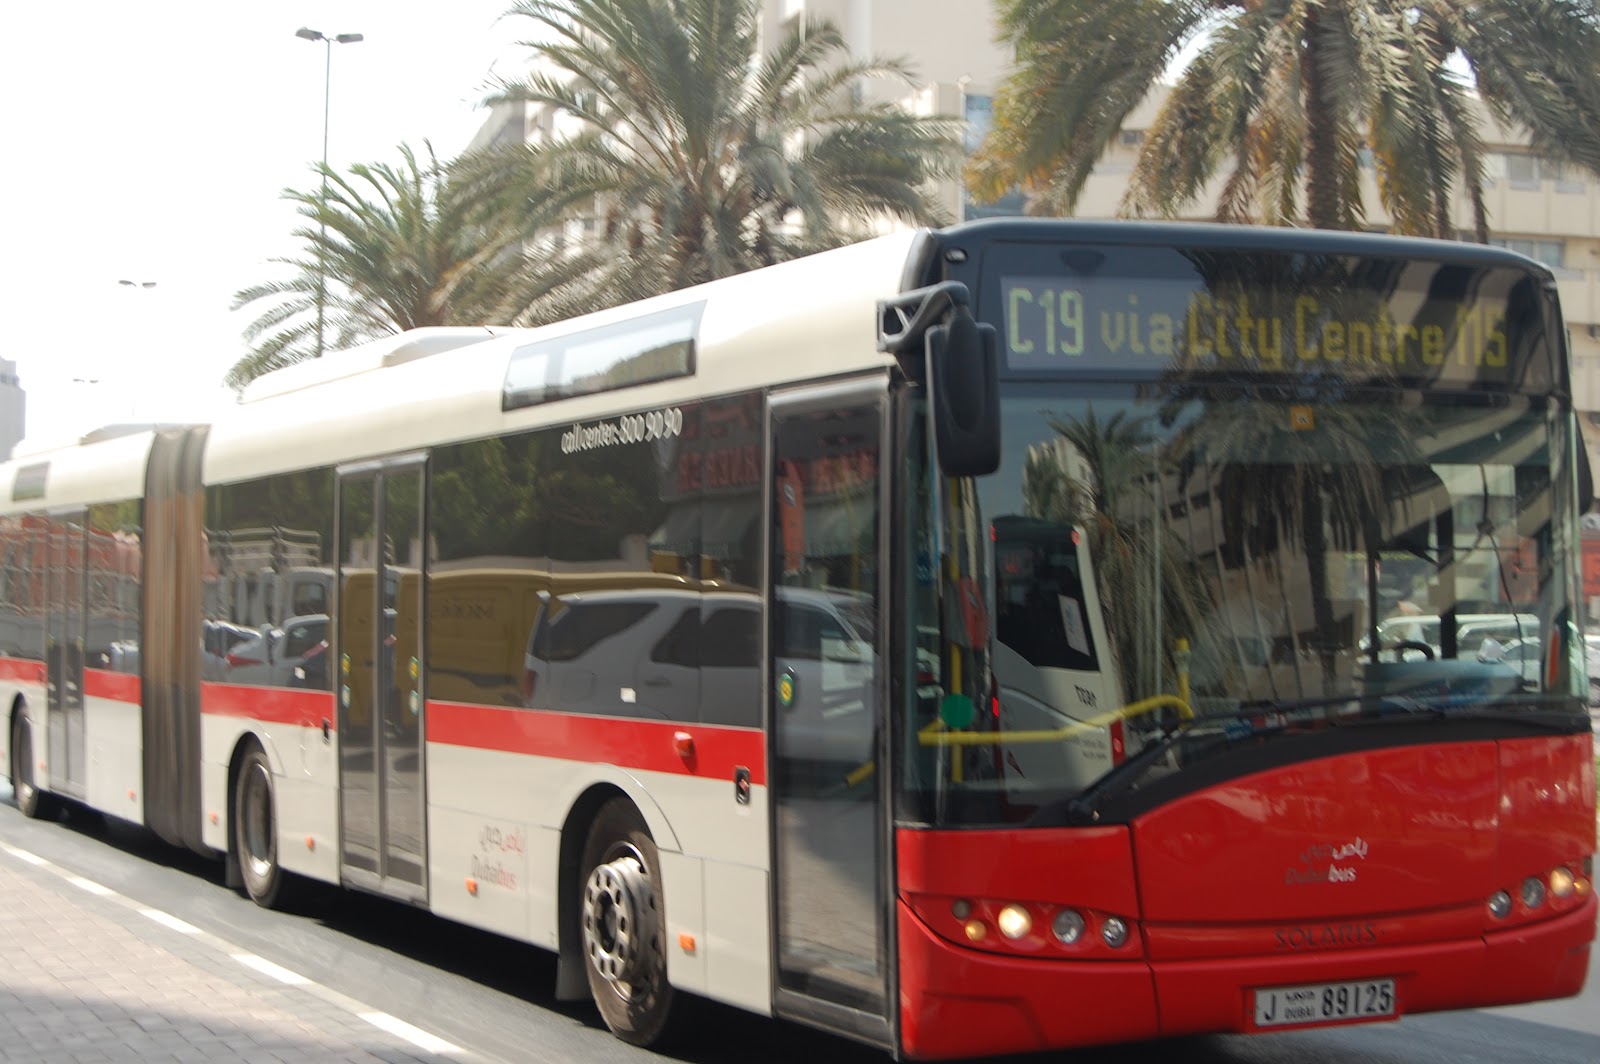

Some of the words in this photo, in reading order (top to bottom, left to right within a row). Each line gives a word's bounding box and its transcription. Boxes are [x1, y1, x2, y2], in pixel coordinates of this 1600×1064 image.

[1008, 287, 1084, 357] C19
[1102, 294, 1173, 355] via
[1186, 290, 1281, 370] City
[1296, 294, 1446, 367] Centre
[644, 411, 664, 442] 90
[663, 407, 683, 440] 90
[1274, 923, 1378, 951] SOLARIS
[1264, 992, 1277, 1021] J
[1321, 982, 1393, 1017] 89125
